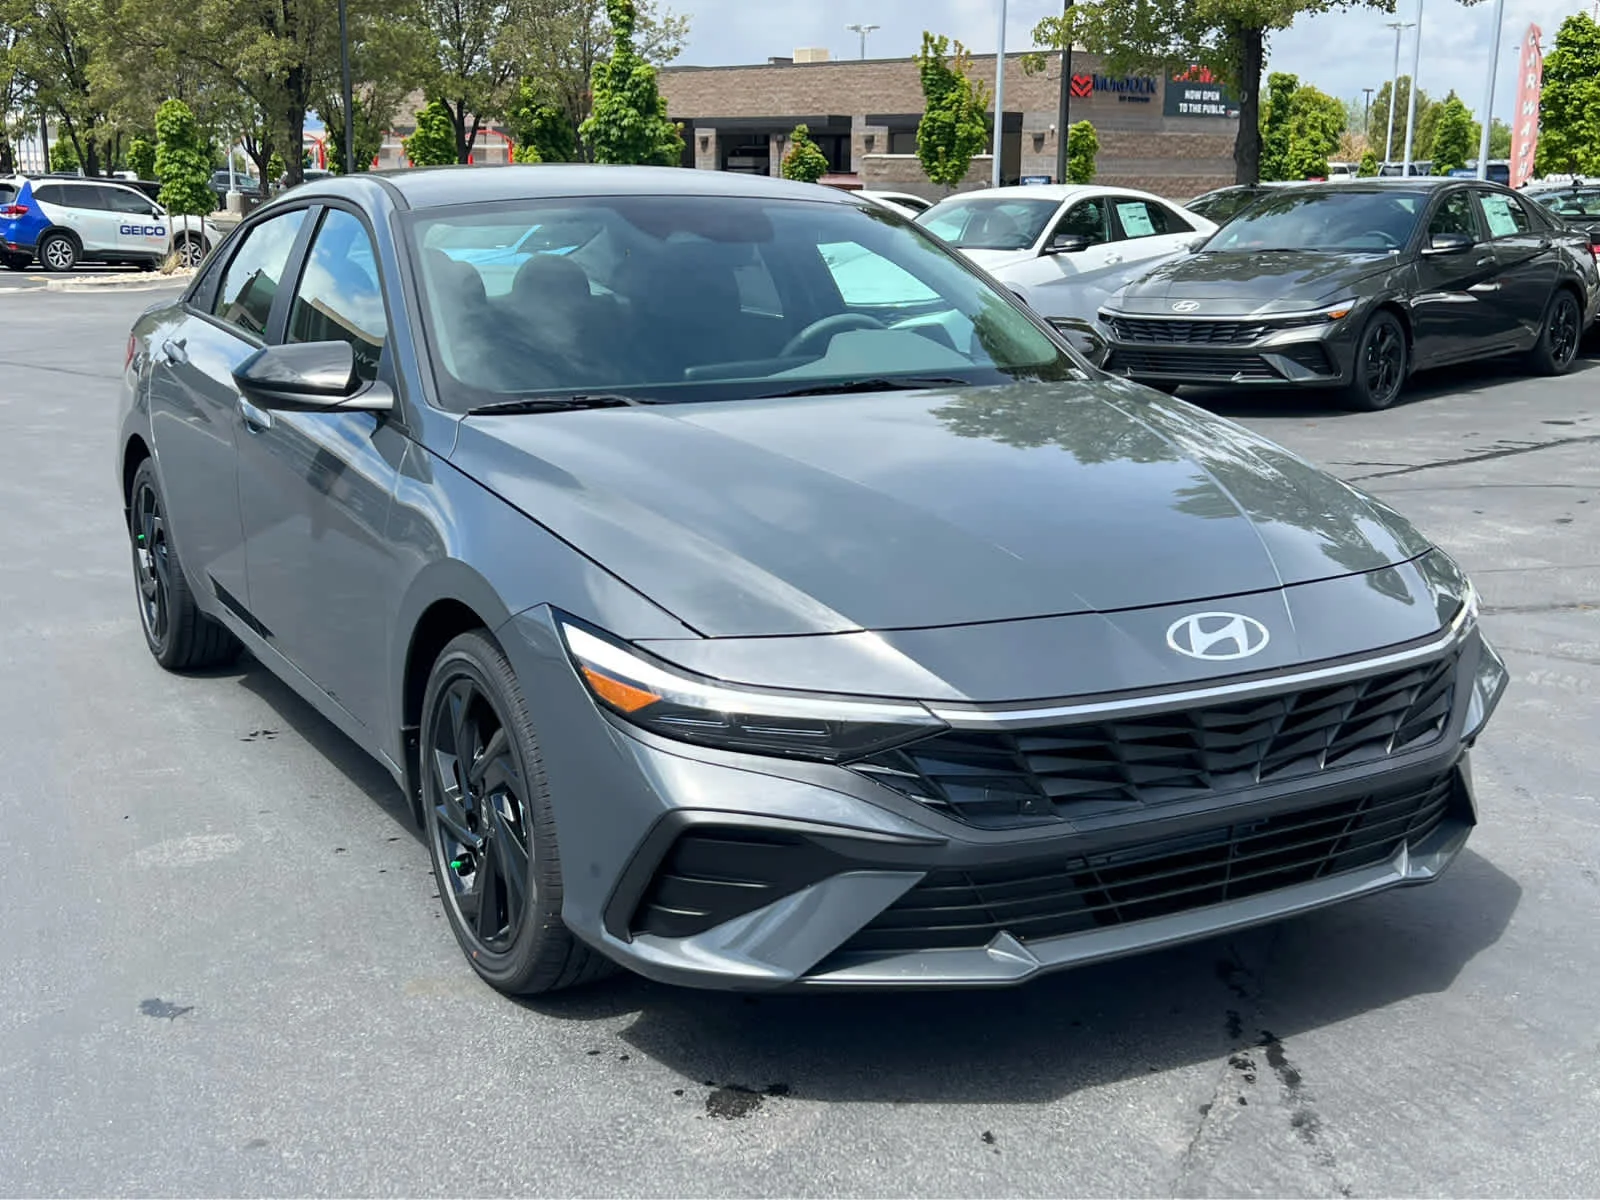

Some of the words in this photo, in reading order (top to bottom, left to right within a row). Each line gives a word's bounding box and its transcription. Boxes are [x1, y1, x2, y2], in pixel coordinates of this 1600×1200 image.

[1525, 33, 1537, 89] CAR
[1185, 90, 1201, 100] NOW
[1202, 91, 1220, 101] OPEN
[1179, 103, 1187, 112] TO
[1189, 104, 1201, 113] THE
[1203, 104, 1225, 114] PUBLIC
[1517, 101, 1535, 177] WASH
[120, 225, 165, 236] GEICO
